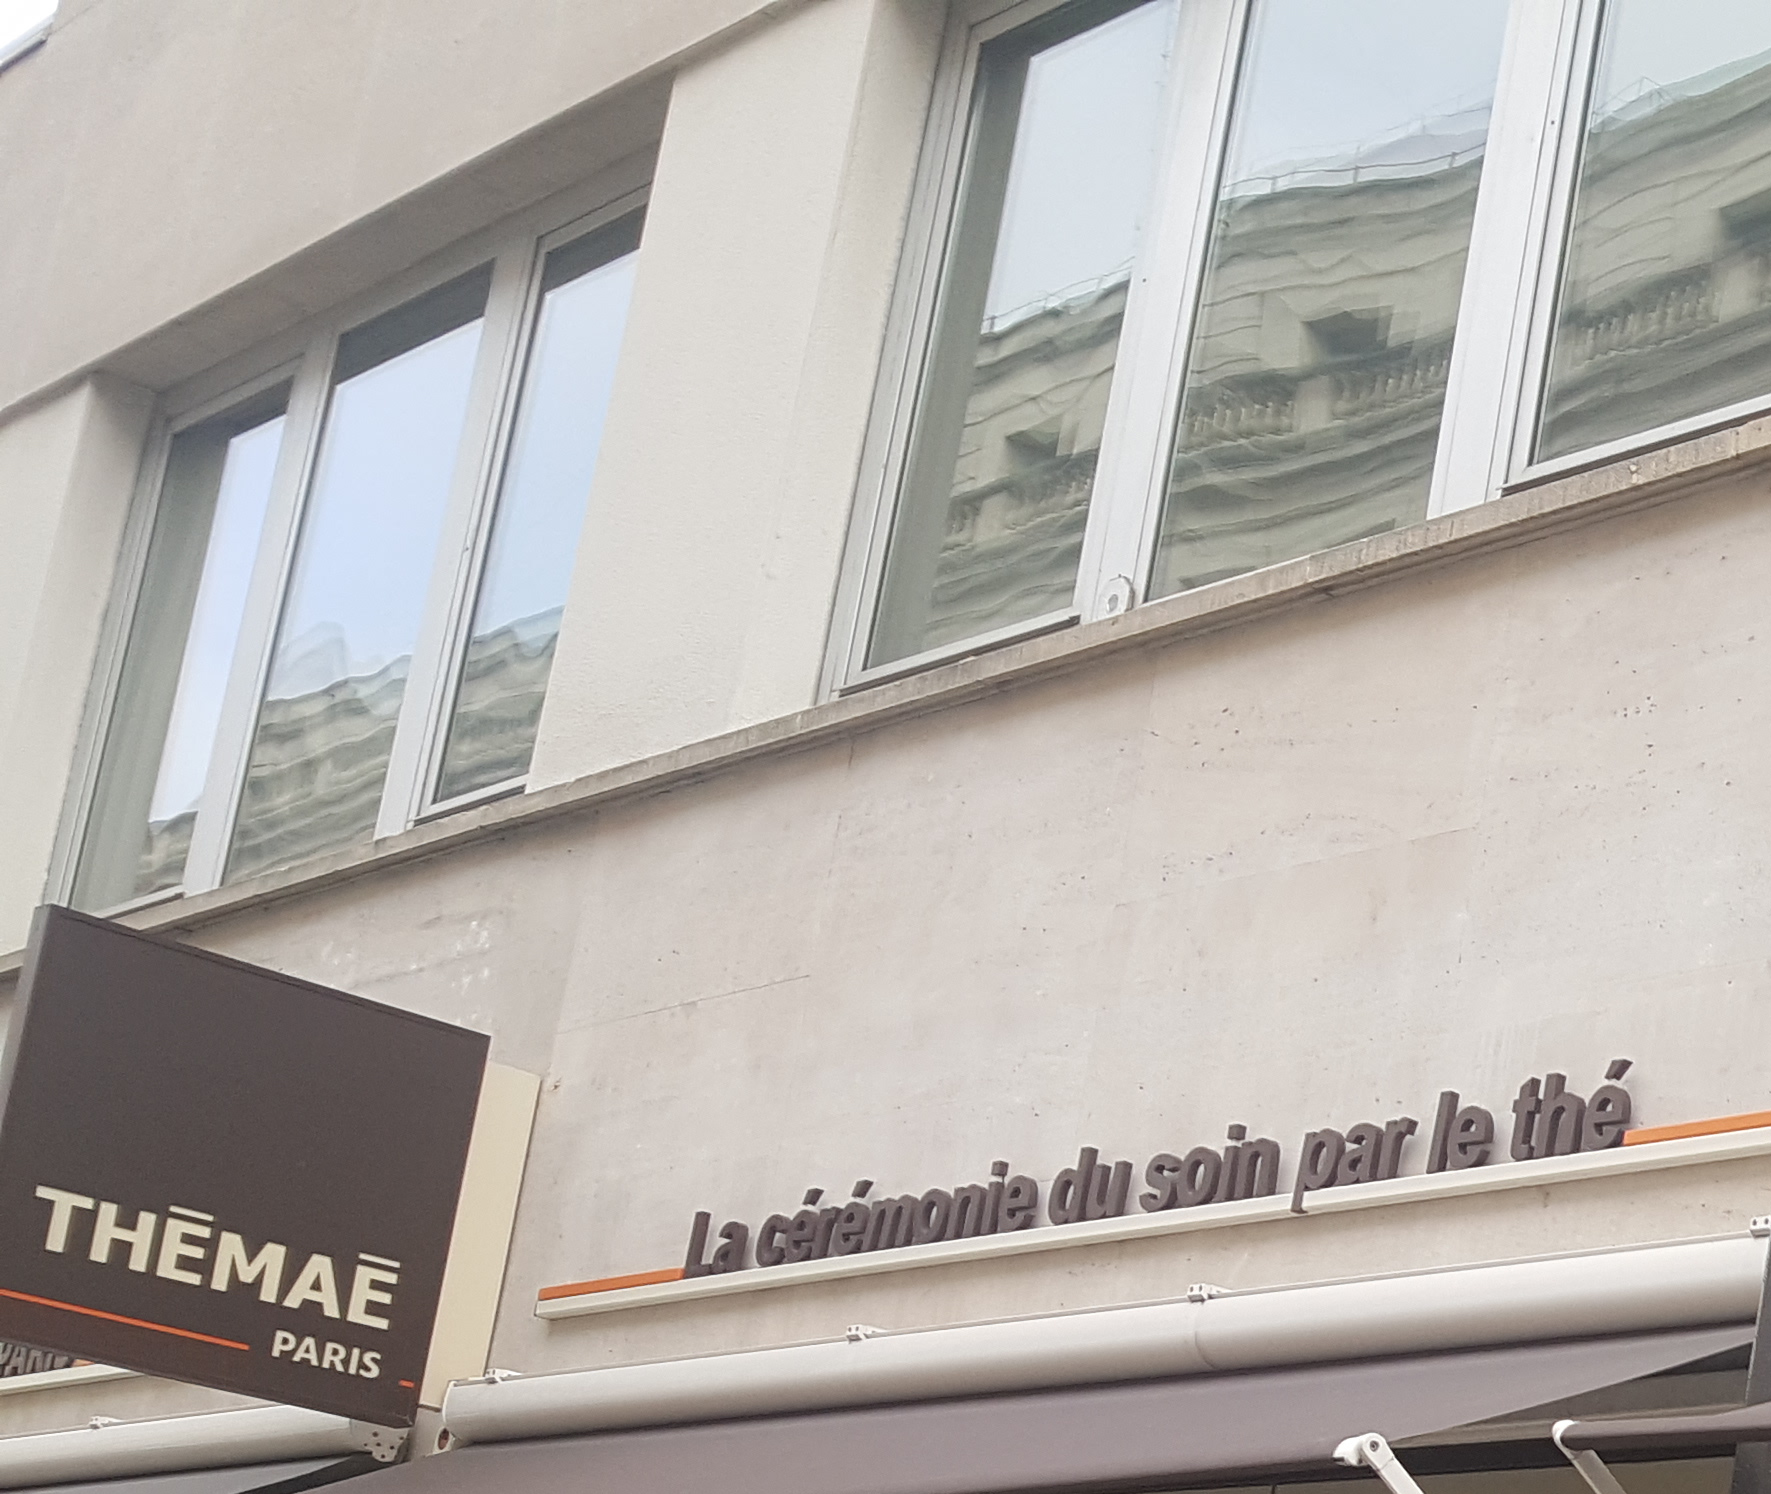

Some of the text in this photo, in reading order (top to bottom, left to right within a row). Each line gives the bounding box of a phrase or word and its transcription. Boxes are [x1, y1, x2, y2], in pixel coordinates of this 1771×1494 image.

[684, 1059, 1633, 1279] La cérémonie du soin par le thé
[272, 1331, 382, 1379] PARIS
